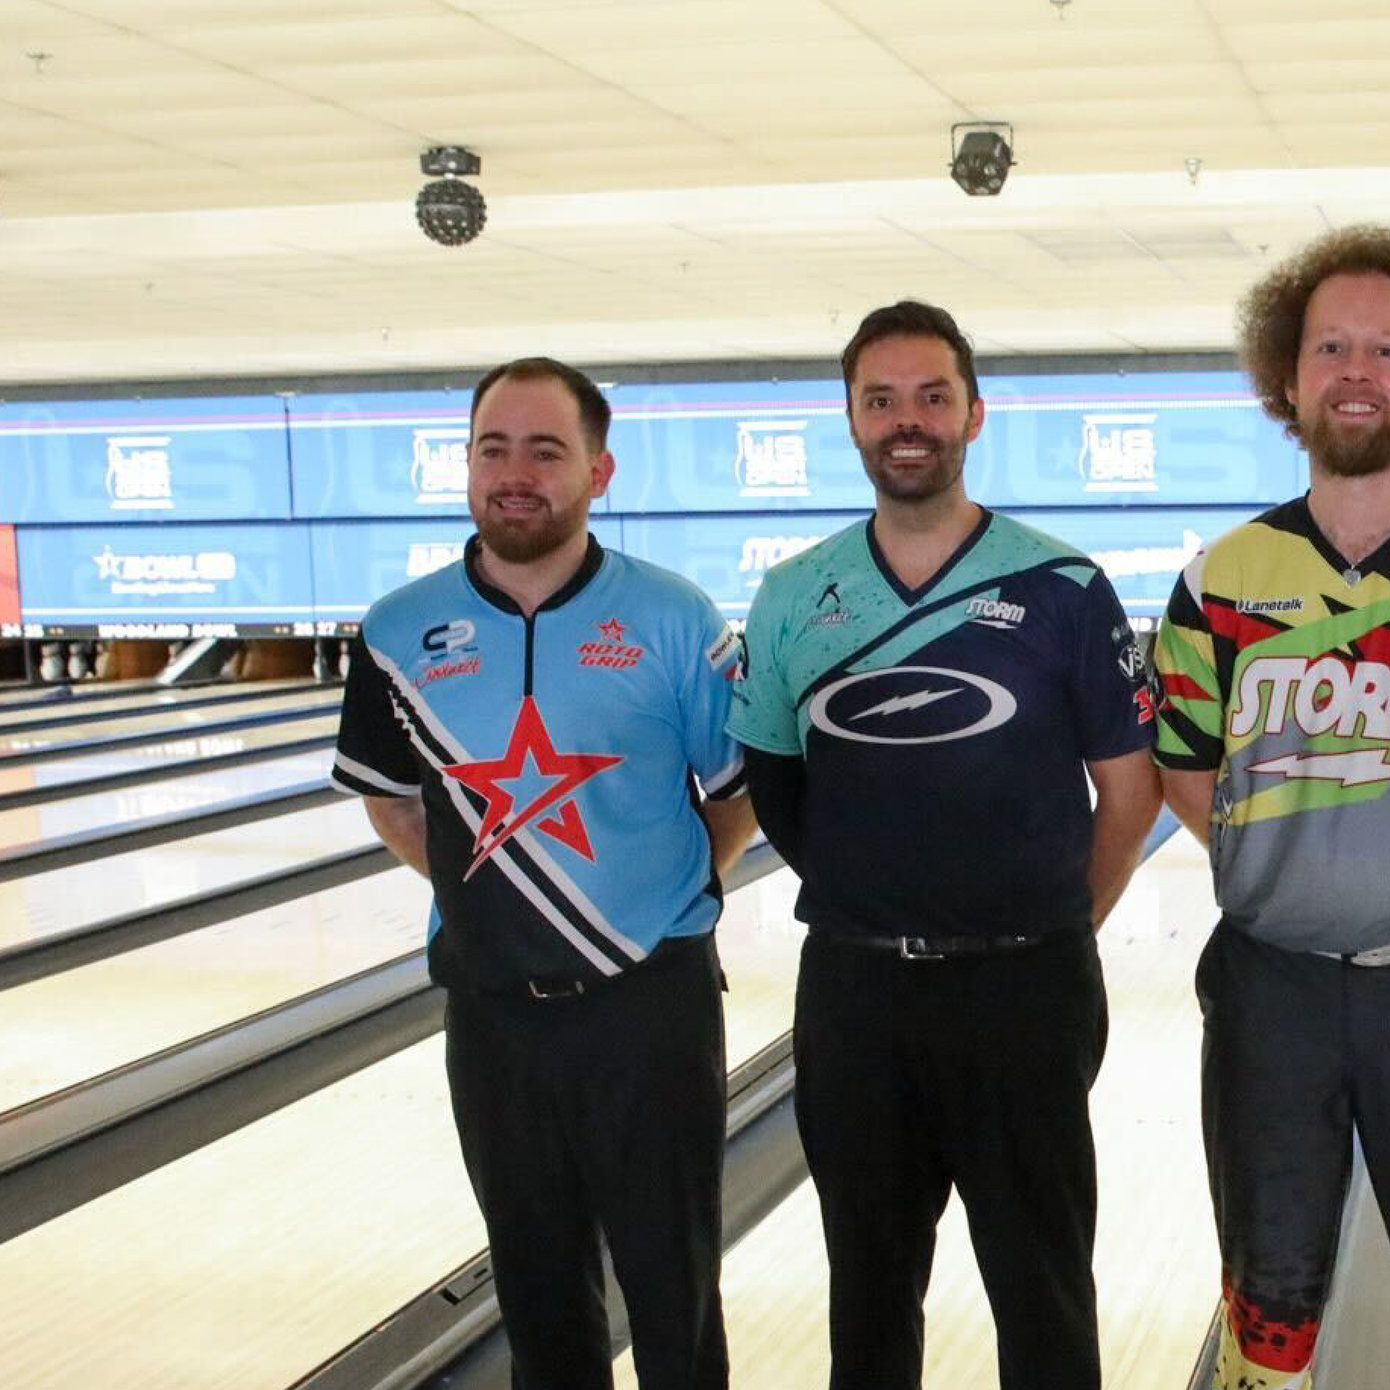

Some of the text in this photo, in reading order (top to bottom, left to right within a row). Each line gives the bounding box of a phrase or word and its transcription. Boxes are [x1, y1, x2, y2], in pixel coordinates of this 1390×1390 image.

[965, 598, 1026, 623] STORM
[1245, 599, 1303, 613] Lanetalk
[578, 642, 643, 658] ROTO
[579, 656, 638, 669] GRIP
